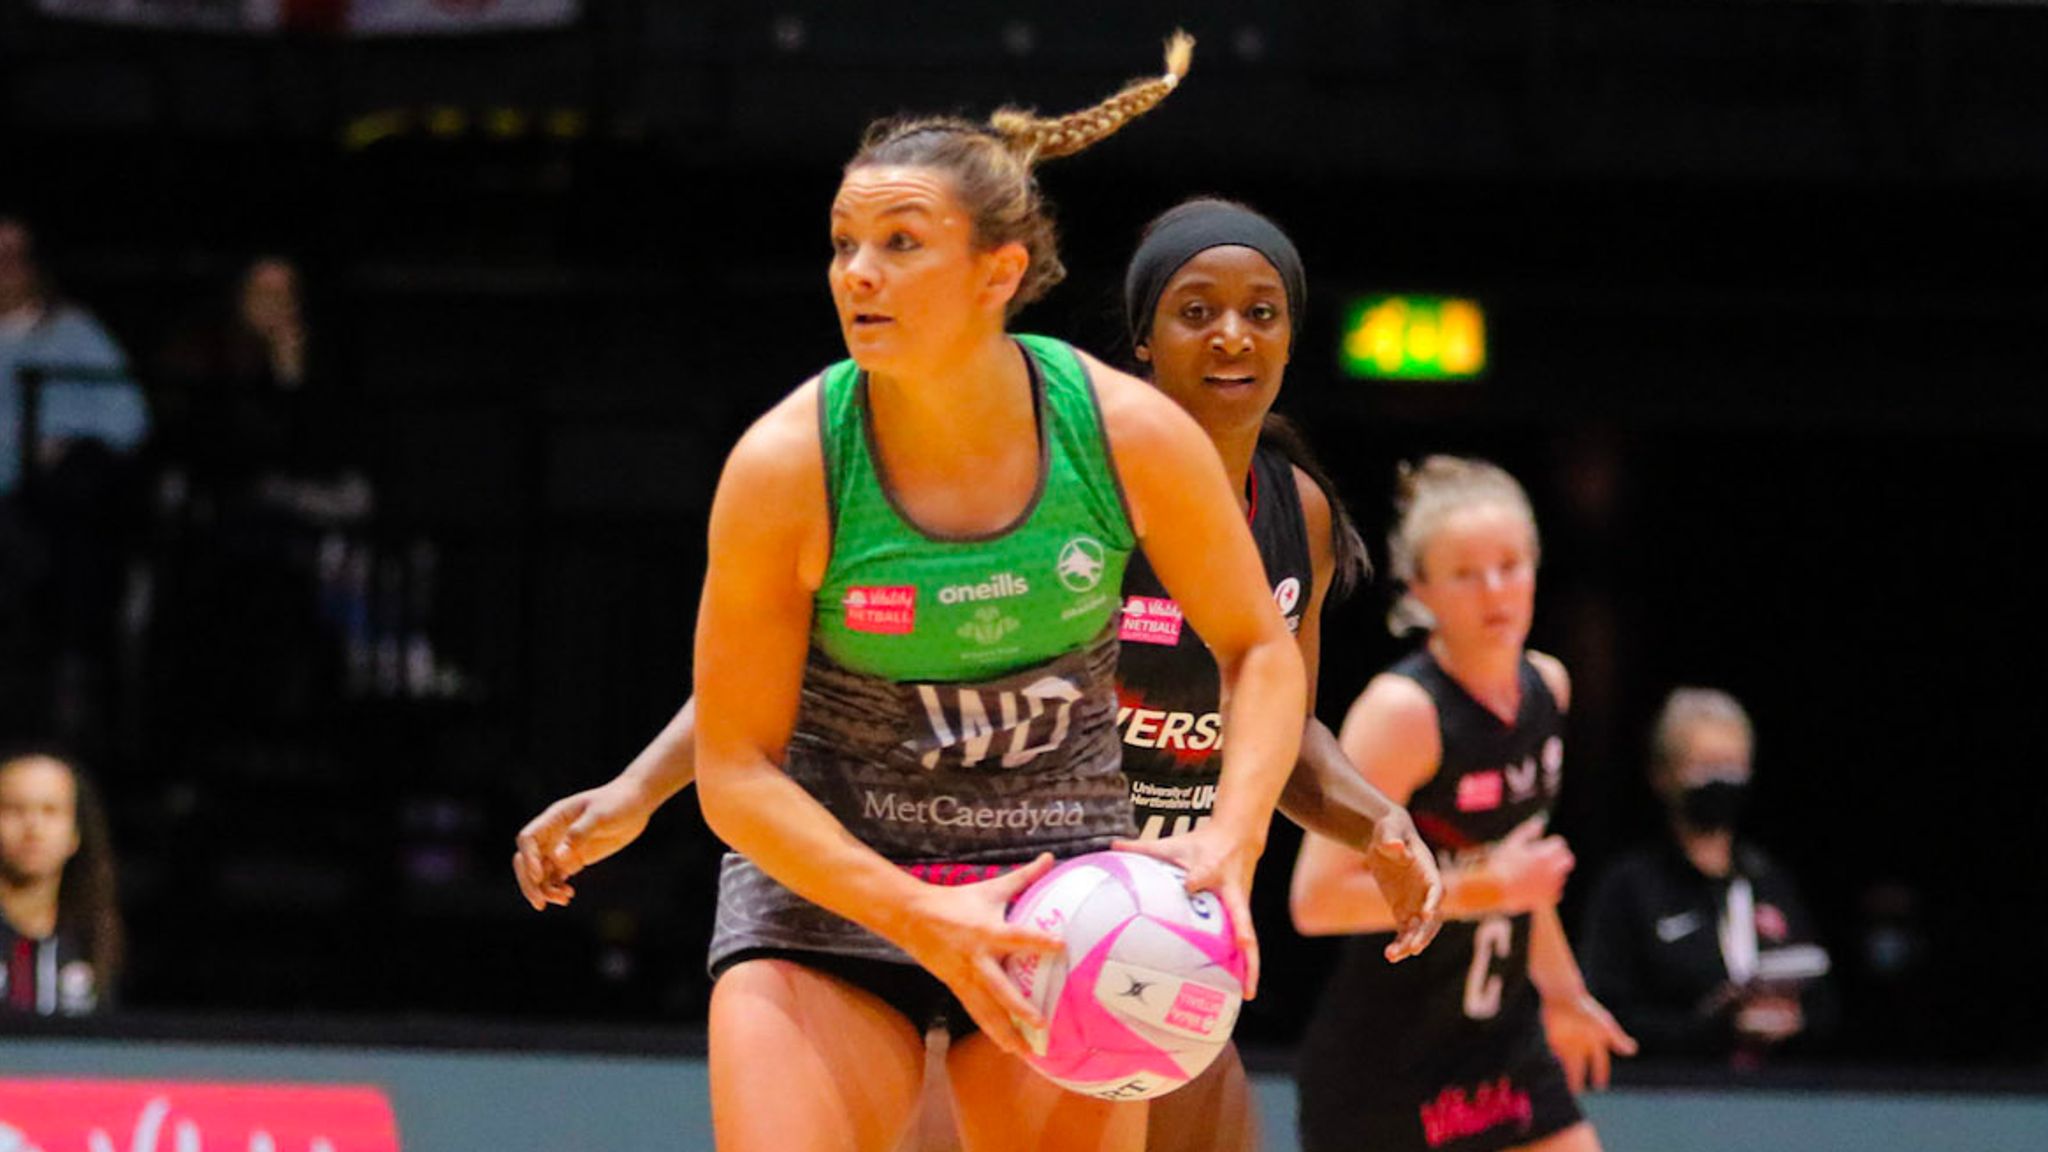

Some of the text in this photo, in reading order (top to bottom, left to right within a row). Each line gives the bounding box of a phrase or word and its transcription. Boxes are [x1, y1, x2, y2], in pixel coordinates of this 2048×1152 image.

[1122, 617, 1179, 636] NETBALL
[903, 676, 1083, 770] WD
[1116, 705, 1224, 751] ERS
[863, 789, 1085, 835] MetCaerdydd
[1463, 915, 1513, 1019] C
